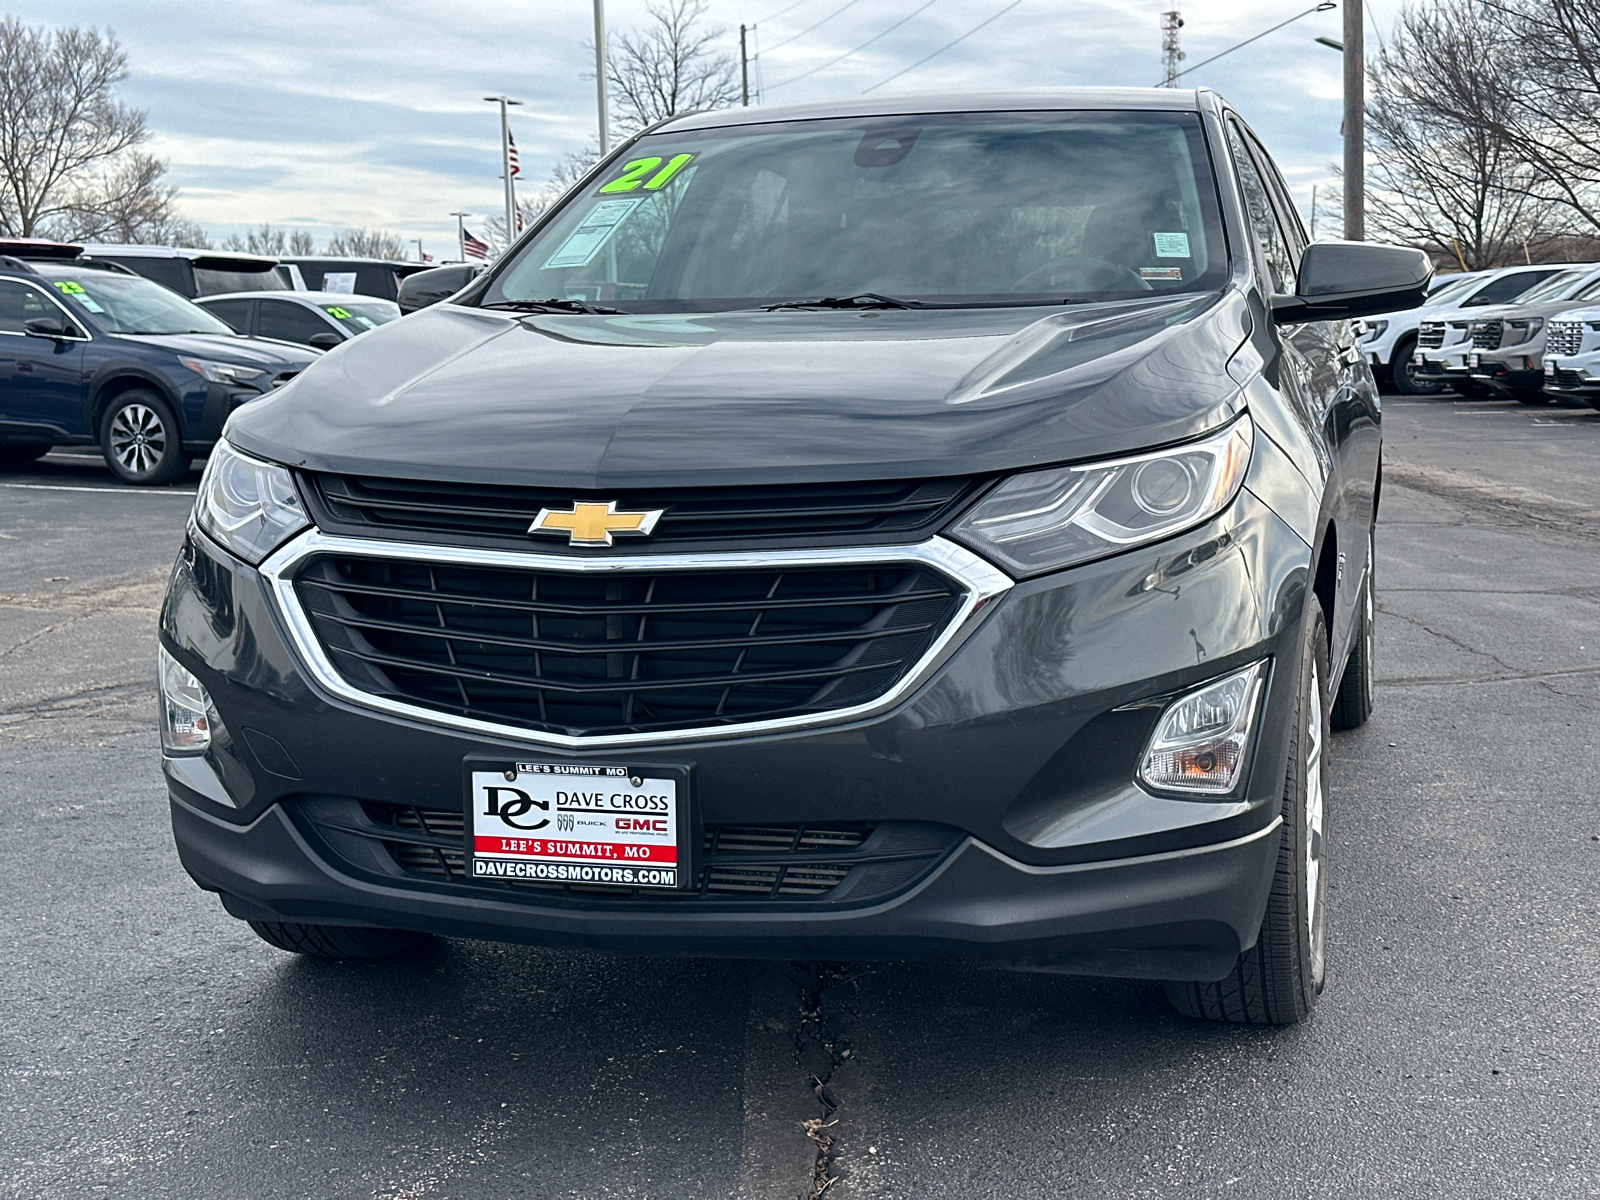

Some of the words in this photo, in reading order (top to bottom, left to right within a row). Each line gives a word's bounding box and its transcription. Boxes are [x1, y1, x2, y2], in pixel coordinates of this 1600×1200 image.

[599, 153, 694, 194] 21
[53, 280, 85, 294] 23
[326, 306, 353, 319] 21
[518, 763, 551, 774] LEE'S
[553, 765, 602, 776] SUMMIT
[606, 767, 625, 777] MO
[556, 791, 604, 808] DAVE
[610, 793, 669, 811] CROSS
[615, 818, 668, 831] GMC
[501, 839, 542, 853] LEE'S
[547, 842, 618, 859] SUMMIT,
[624, 846, 650, 858] MO
[475, 861, 674, 884] DAVECROSSMOTORS.COM
